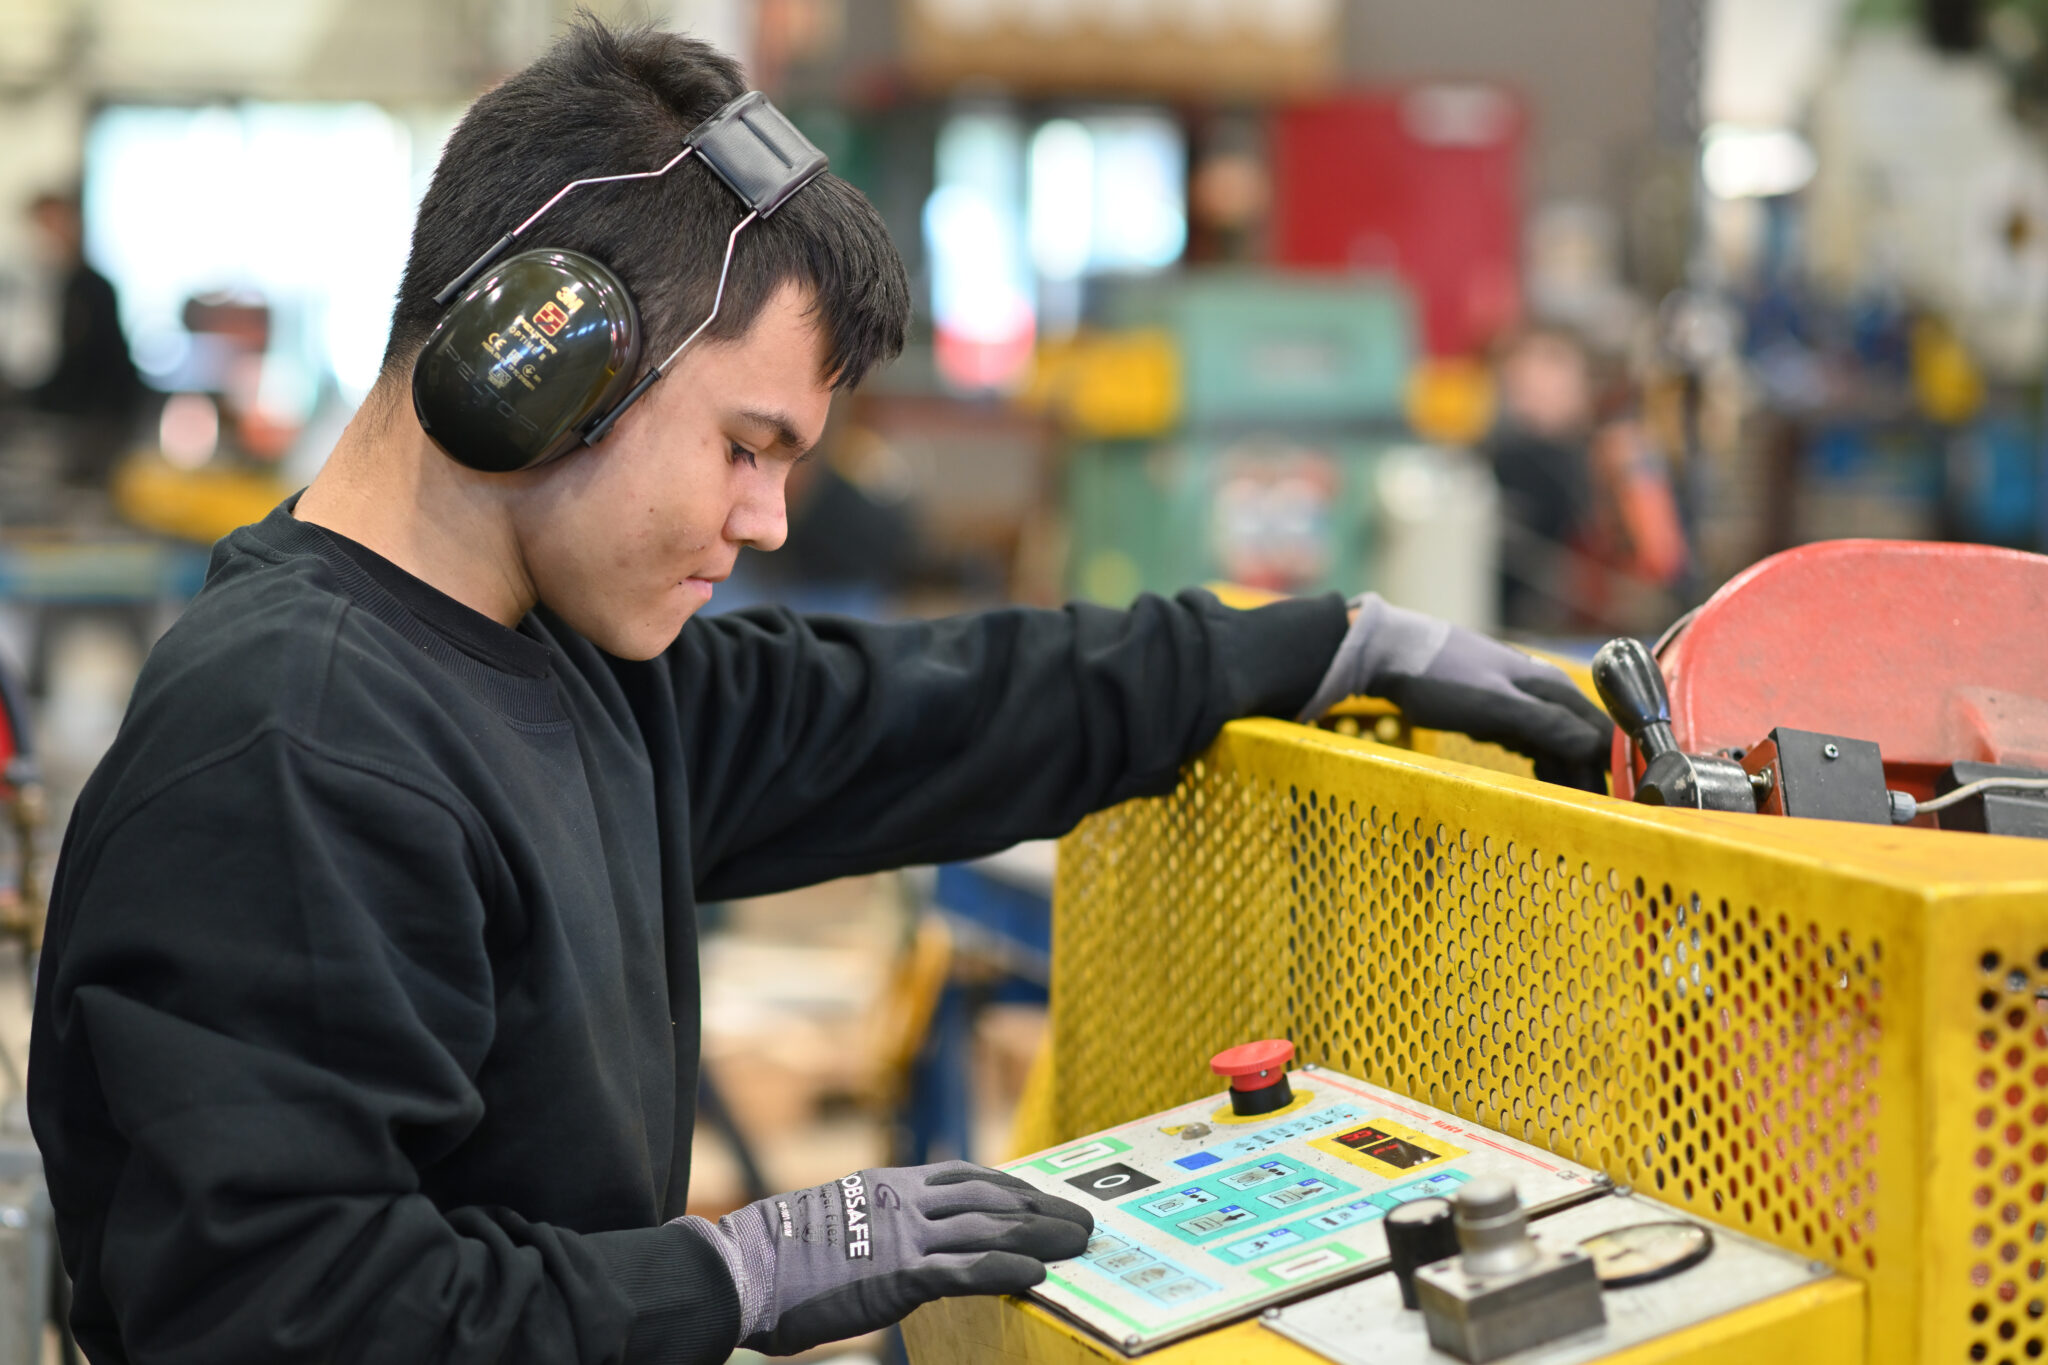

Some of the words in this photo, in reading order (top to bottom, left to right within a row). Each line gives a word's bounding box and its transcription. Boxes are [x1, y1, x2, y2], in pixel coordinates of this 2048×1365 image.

[555, 285, 585, 314] 3M
[488, 332, 507, 351] CE
[509, 326, 538, 355] OPTIME
[514, 315, 558, 355] PELTOR
[825, 1214, 840, 1247] Flex
[841, 1173, 870, 1258] OBSAFE
